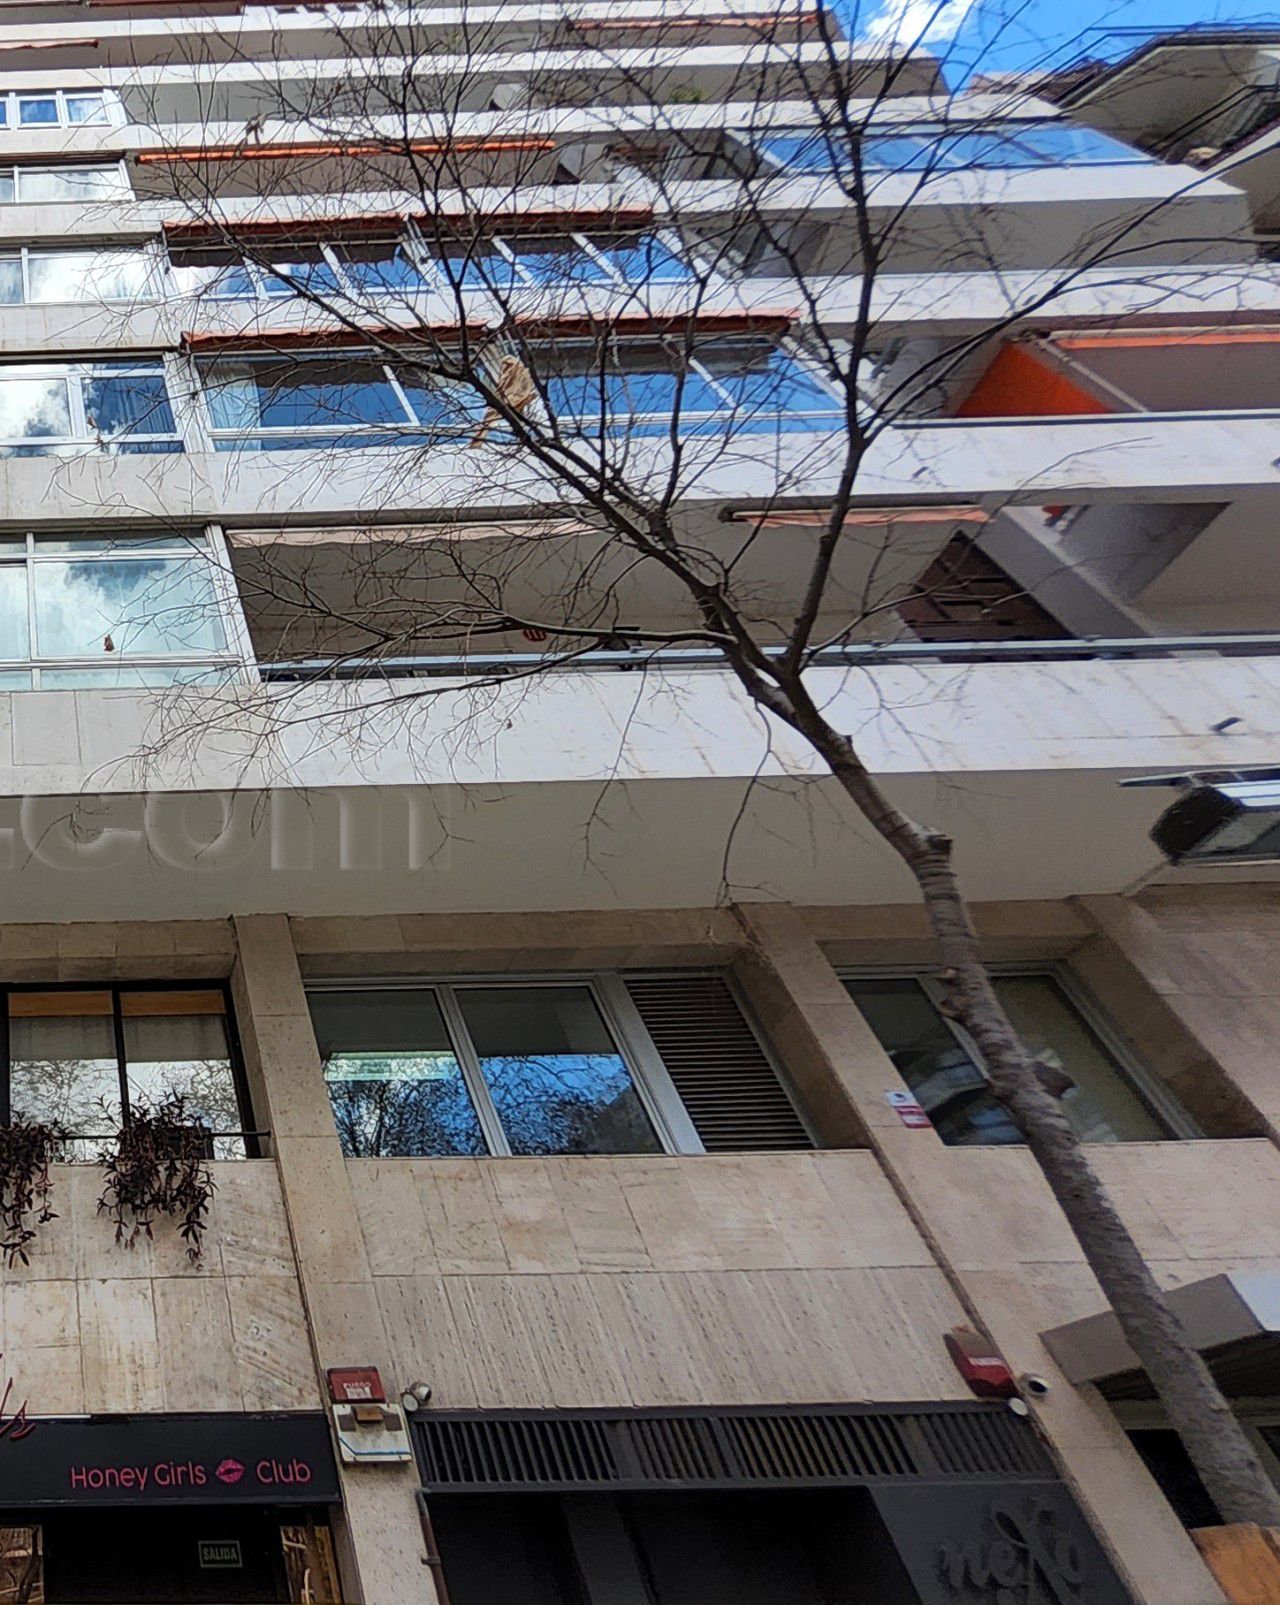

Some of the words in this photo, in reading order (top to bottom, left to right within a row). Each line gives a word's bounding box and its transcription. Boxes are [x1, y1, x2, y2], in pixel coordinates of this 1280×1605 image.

[70, 1465, 149, 1492] Honey
[153, 1460, 208, 1486] Girls
[255, 1457, 313, 1484] Club
[201, 1545, 239, 1561] SALIDA
